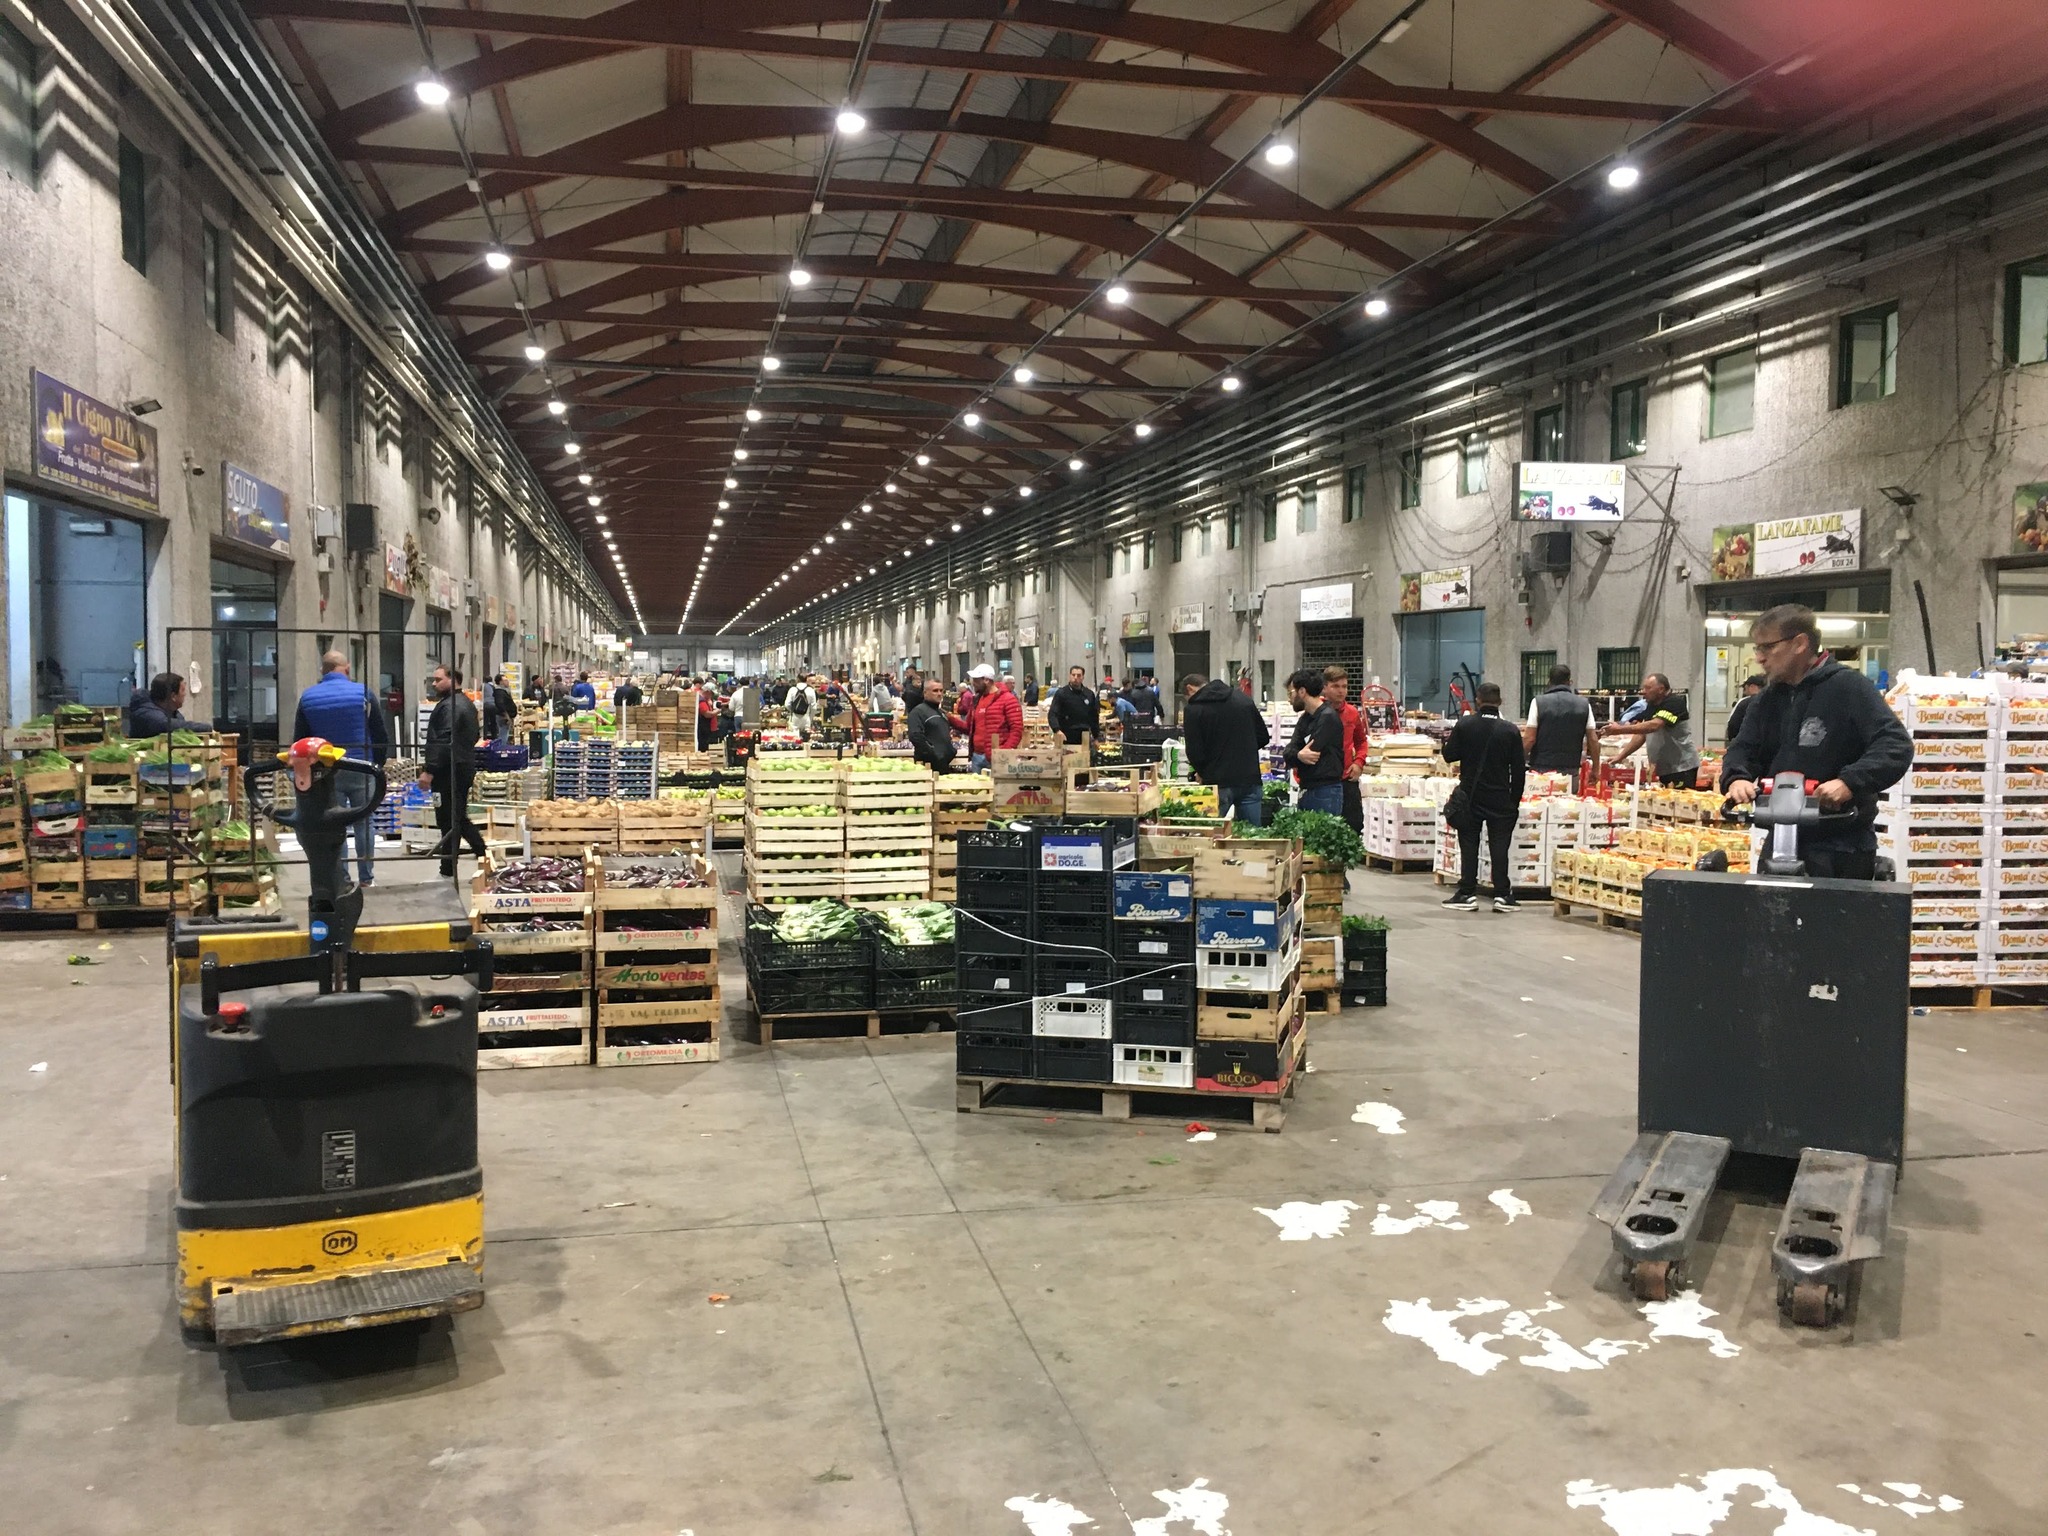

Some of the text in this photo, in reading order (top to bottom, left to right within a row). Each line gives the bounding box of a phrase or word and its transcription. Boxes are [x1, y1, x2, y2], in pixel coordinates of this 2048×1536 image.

[63, 391, 72, 419] Il
[76, 399, 112, 437] Cigno
[228, 470, 258, 510] SCUTO
[1757, 514, 1843, 541] LANZAFAME
[1832, 558, 1854, 567] BOX 24
[1955, 711, 1986, 723] Sapori
[1952, 743, 1983, 756] Sapori
[1951, 776, 1981, 789] Sapori
[1948, 840, 1979, 853] Sapori
[1946, 871, 1977, 884] Sapori
[495, 898, 531, 908] ASTA
[1944, 934, 1974, 946] Sapori
[630, 1008, 698, 1018] VAL TREBBIA
[487, 1016, 525, 1026] ASTA
[1217, 1073, 1257, 1084] BICOCA
[328, 1236, 352, 1249] OM
